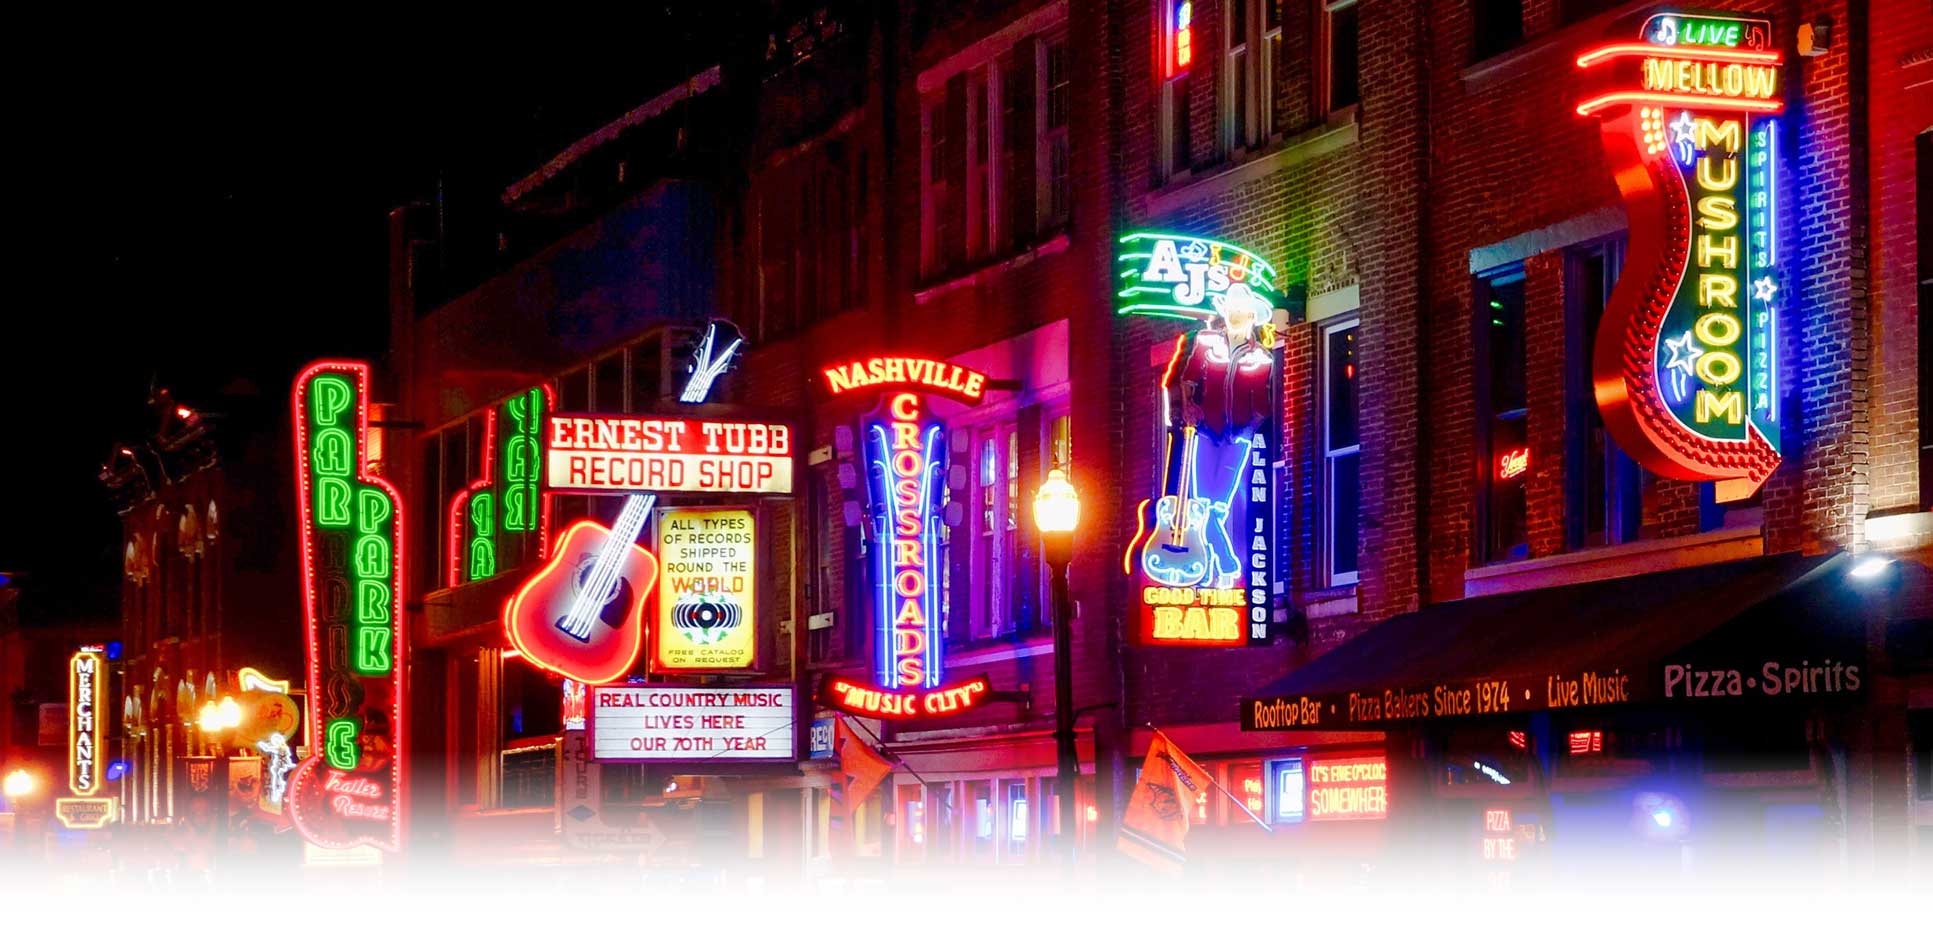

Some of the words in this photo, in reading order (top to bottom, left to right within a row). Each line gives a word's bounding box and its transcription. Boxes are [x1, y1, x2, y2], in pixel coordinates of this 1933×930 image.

[1685, 22, 1739, 46] LIVE
[1644, 59, 1776, 98] MELLOW
[1756, 131, 1767, 268] SPIRITS
[1694, 119, 1742, 424] MUSHROOM
[1757, 312, 1768, 409] PIZZA
[825, 357, 985, 397] NASHVILLE
[551, 419, 686, 452] ERNEST
[703, 424, 790, 454] TUBB
[569, 456, 684, 487] RECORD
[700, 462, 773, 489] SHOP
[1252, 434, 1266, 502] ALAN
[664, 534, 682, 544] OF
[689, 534, 751, 544] RECORDS
[670, 520, 694, 530] ALL
[704, 519, 745, 530] TYPES
[892, 393, 924, 687] CROSSROADS
[667, 563, 713, 573] ROUND
[723, 562, 746, 572] THE
[680, 548, 736, 558] SHIPPED
[357, 490, 390, 672] PARK
[672, 576, 744, 594] WORLD
[1252, 518, 1266, 639] JACKSON
[1143, 587, 1194, 605] GOOD
[1199, 588, 1247, 606] TIME
[1153, 607, 1240, 640] BAR
[1664, 664, 1743, 698] Pizza
[1762, 660, 1861, 694] Spirits
[600, 693, 645, 707] REAL
[649, 693, 728, 707] COUNTRY
[732, 692, 783, 707] MUSIC
[1254, 699, 1299, 729] Rooftop
[1301, 697, 1321, 725] Bar
[1349, 692, 1380, 721] Pizza
[1384, 688, 1428, 719] Bakers
[1434, 685, 1471, 715] Since
[1476, 681, 1510, 712] 1974
[1547, 675, 1579, 707] Live
[1583, 670, 1629, 703] Music
[76, 658, 93, 790] MERCHANTS
[644, 715, 694, 729] LIVES
[701, 715, 745, 728] HERE
[630, 738, 666, 751] OUR
[673, 738, 714, 751] 70TH
[723, 737, 767, 751] YEAR
[325, 770, 381, 798] Trailer
[1352, 762, 1386, 780] O'CLOC
[1312, 785, 1387, 815] SOMEWHER
[1487, 811, 1511, 831] PIZZA
[1484, 839, 1497, 859] BY
[1499, 839, 1516, 859] THE
